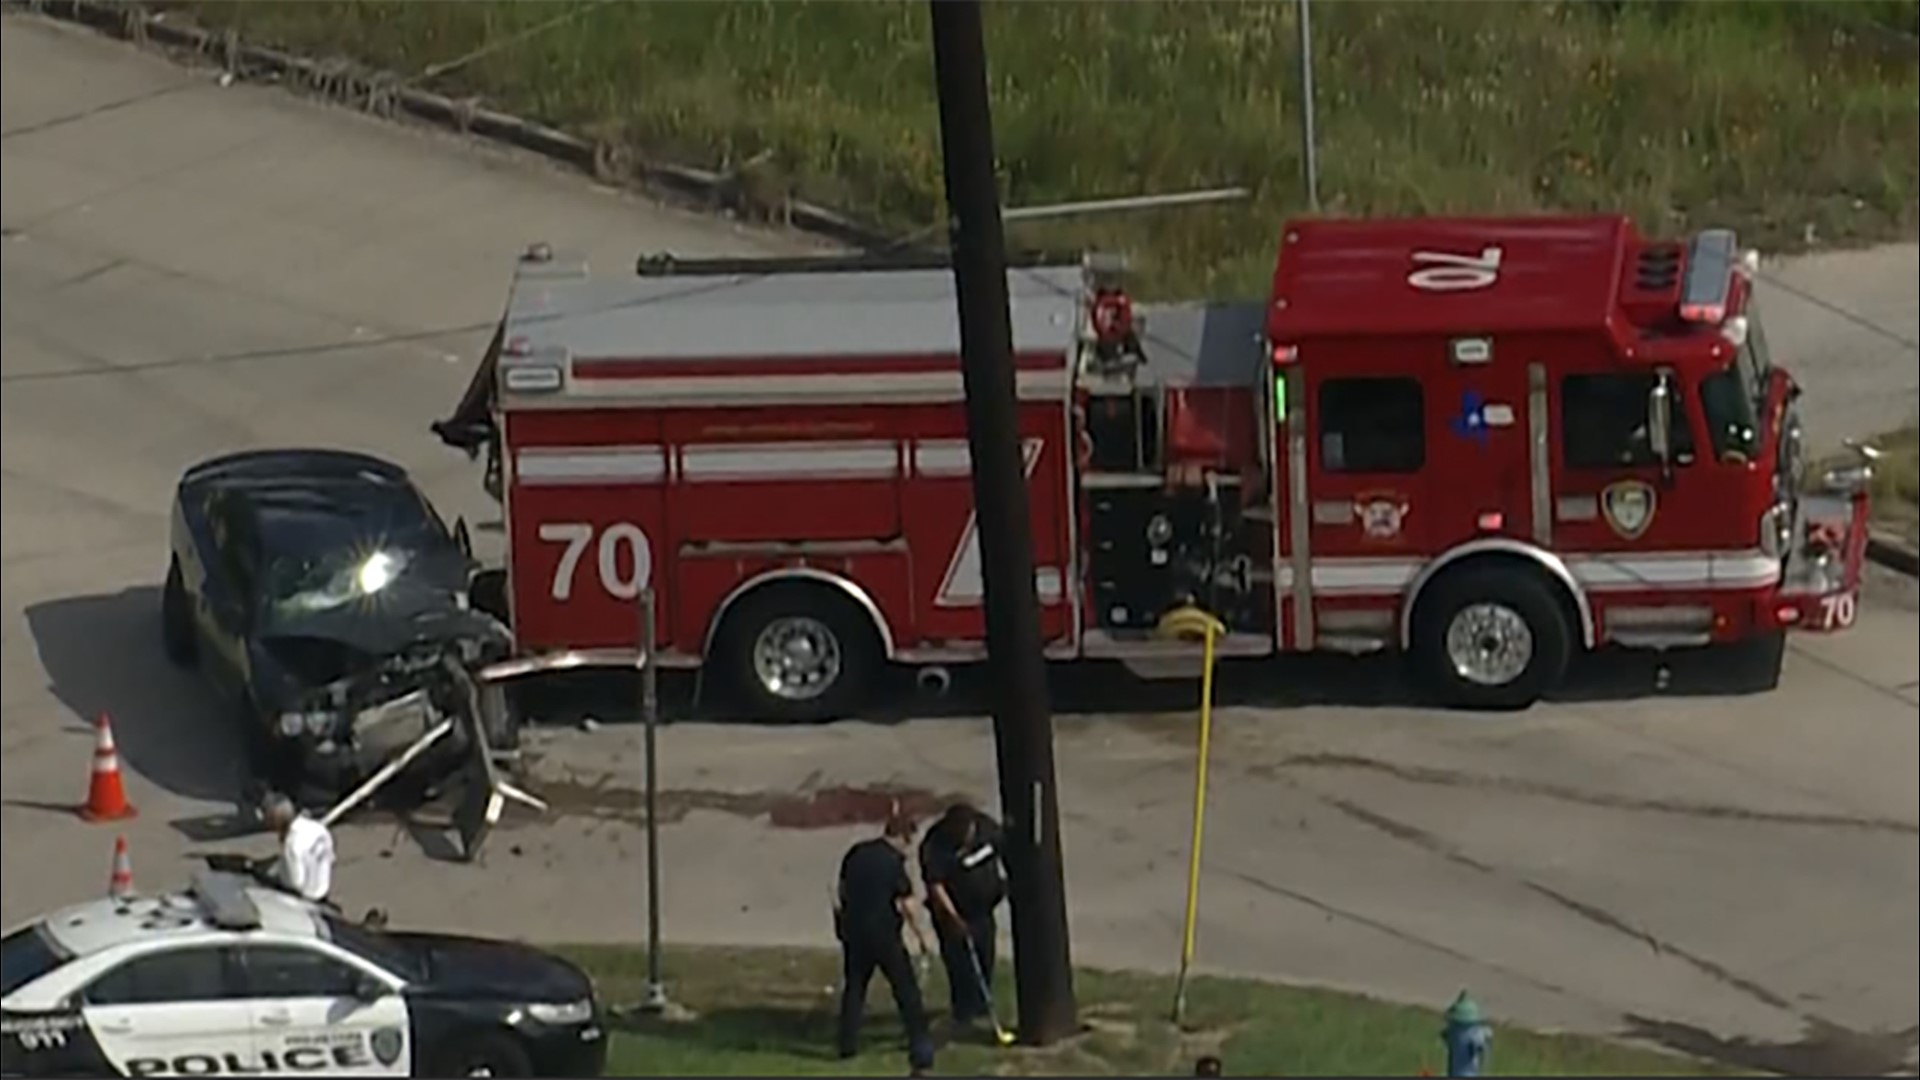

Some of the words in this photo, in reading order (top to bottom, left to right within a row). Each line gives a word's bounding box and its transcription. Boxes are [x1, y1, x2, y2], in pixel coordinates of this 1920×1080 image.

[1408, 247, 1502, 290] 70
[539, 522, 652, 600] 70
[1820, 593, 1854, 629] 70
[125, 1047, 373, 1077] POLICE
